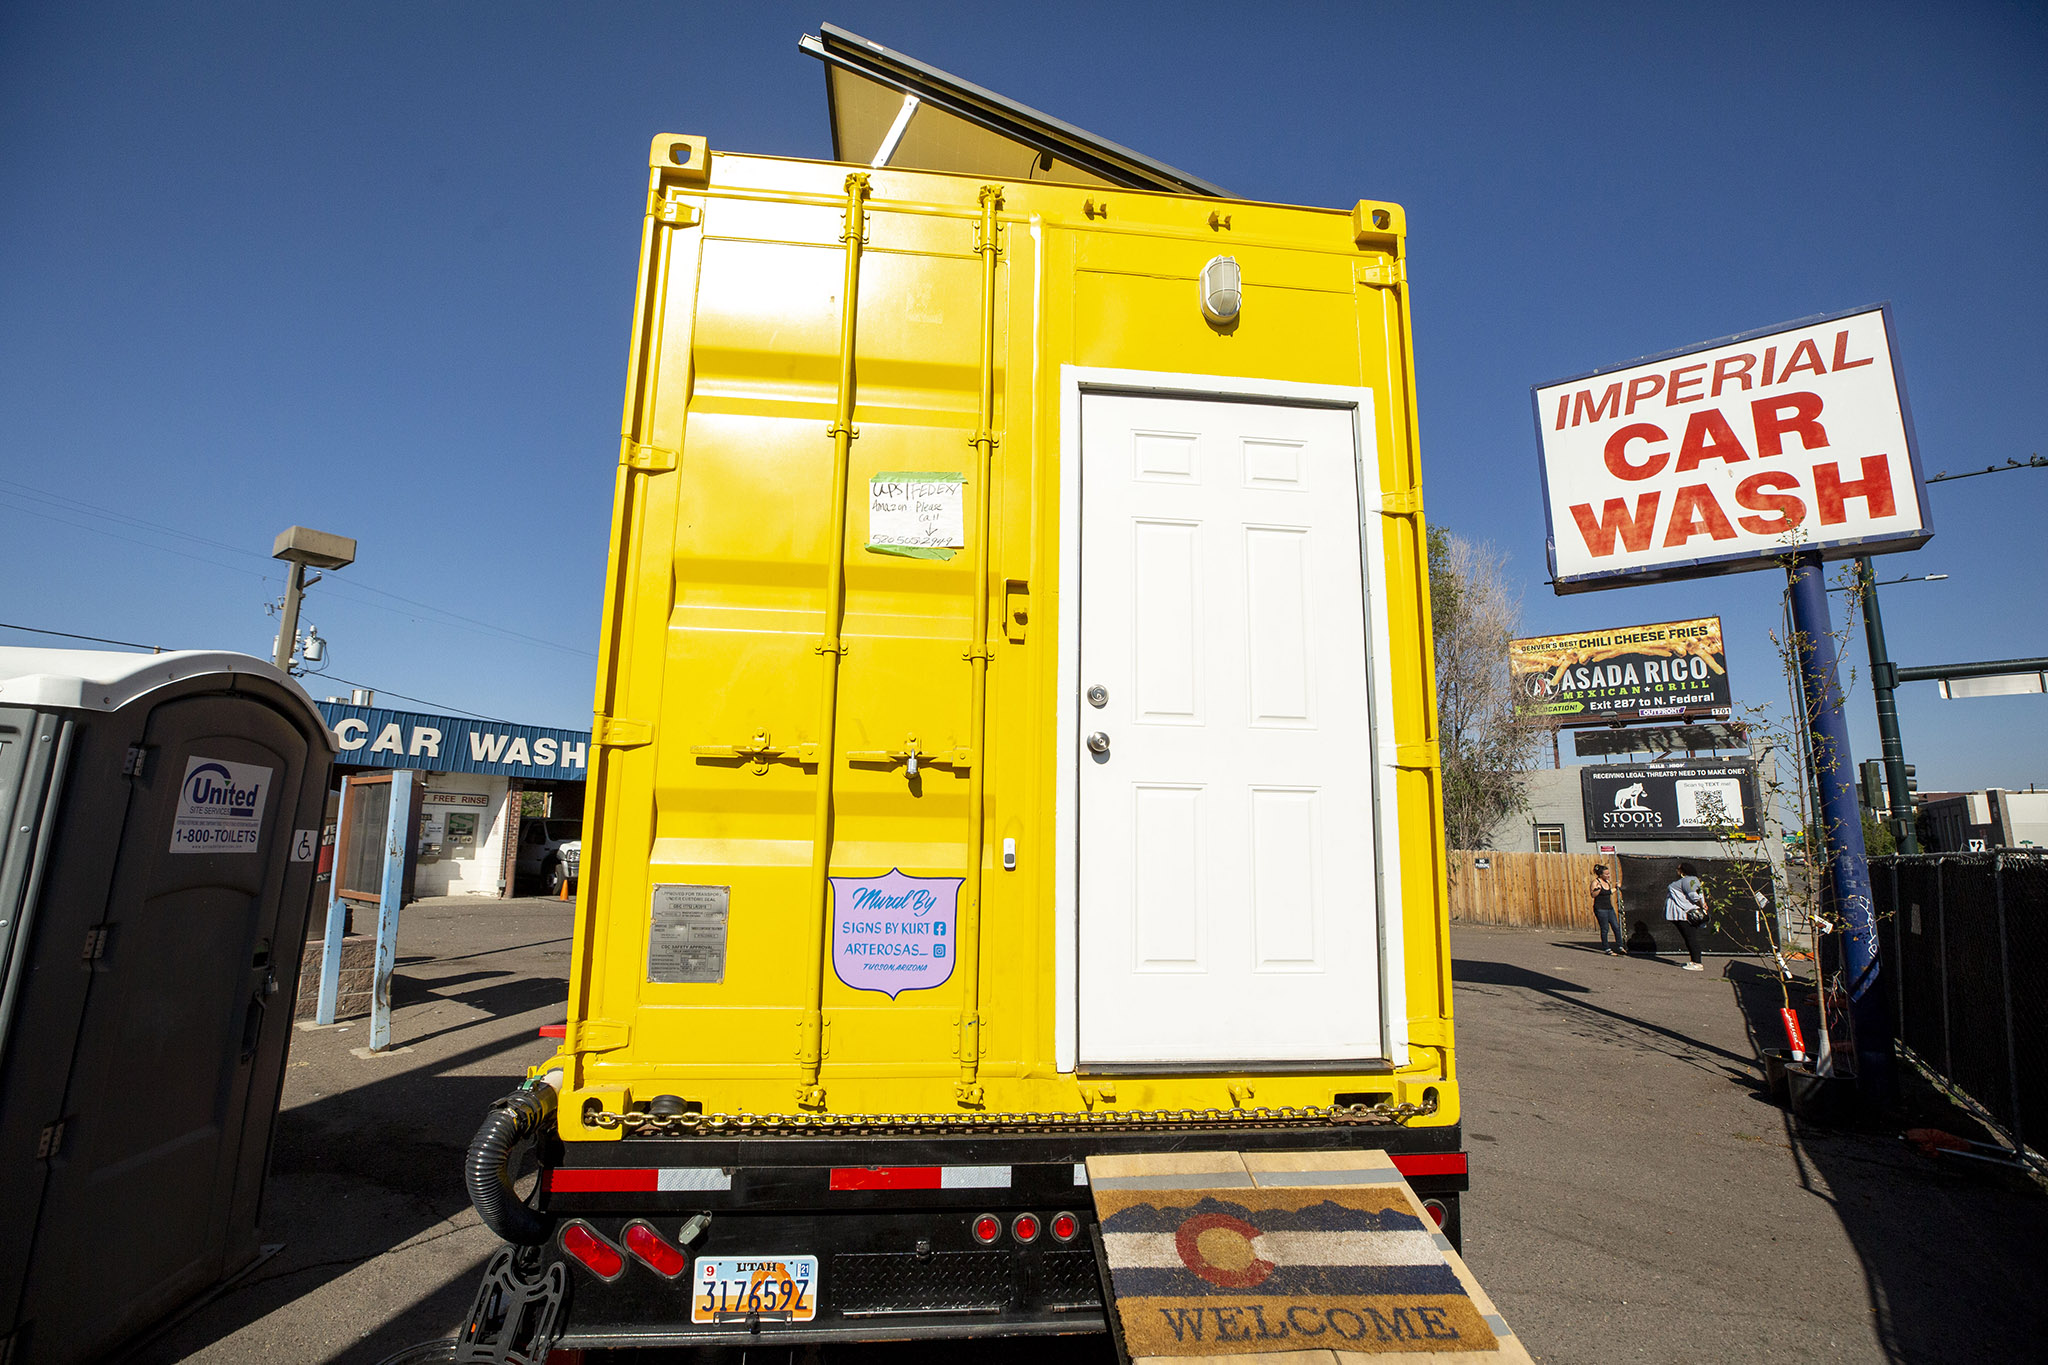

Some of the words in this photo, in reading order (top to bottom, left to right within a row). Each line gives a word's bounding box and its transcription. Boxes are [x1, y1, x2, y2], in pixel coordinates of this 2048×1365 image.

[1555, 330, 1875, 431] IMPERIAL
[1603, 391, 1830, 481] CAR
[916, 501, 943, 512] Please
[1569, 453, 1897, 558] WASH
[1521, 642, 1558, 652] DENVER'S
[1559, 640, 1578, 648] BEST
[1579, 636, 1611, 648] CHILI
[1615, 631, 1665, 645] CHEESE
[1669, 626, 1708, 639] FRIES
[1561, 663, 1640, 691] ASADA
[1563, 686, 1641, 700] MEXICAN
[1654, 680, 1709, 692] GRILL
[1541, 704, 1578, 712] CATION!
[1590, 700, 1612, 710] Exit
[1614, 698, 1636, 709] 287
[1639, 698, 1651, 707] to
[1654, 696, 1667, 706] N.
[1669, 692, 1715, 705] Federal
[333, 718, 442, 758] CAR
[469, 732, 586, 769] WASH
[192, 777, 259, 808] United
[433, 794, 457, 803] FREE
[461, 796, 488, 805] RINSE
[189, 806, 203, 815] SITE
[204, 806, 231, 816] SERVICES
[1603, 811, 1662, 824] STOOPS
[176, 828, 257, 843] 1-800-TOILETS
[852, 887, 915, 910] Mural
[912, 889, 937, 917] By
[842, 921, 882, 934] SIGNS
[885, 922, 899, 934] BY
[901, 922, 931, 935] KURT
[844, 943, 928, 956] ARTEROSAS_
[706, 1265, 715, 1276] 9
[736, 1262, 778, 1272] UTAH
[801, 1264, 809, 1274] 21
[702, 1279, 809, 1312] 317659Z
[1161, 1305, 1460, 1343] WELCOME
